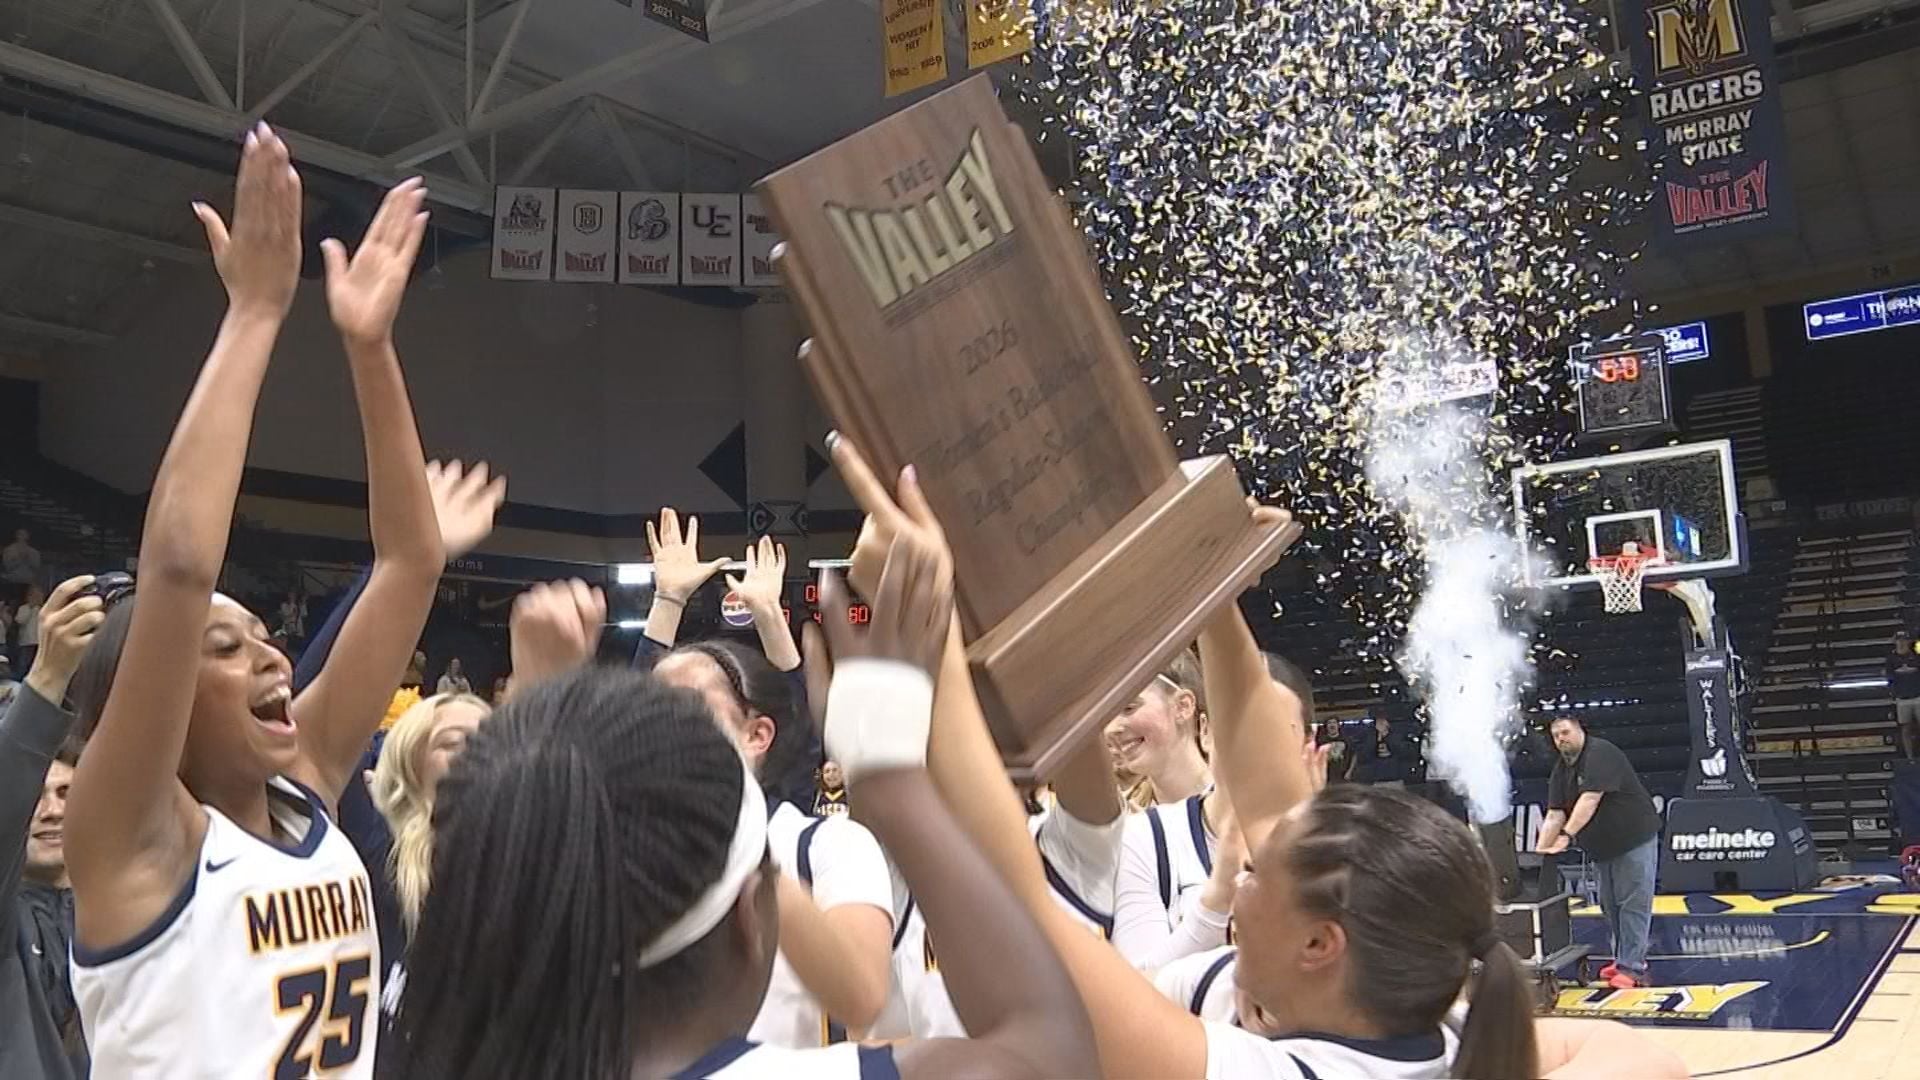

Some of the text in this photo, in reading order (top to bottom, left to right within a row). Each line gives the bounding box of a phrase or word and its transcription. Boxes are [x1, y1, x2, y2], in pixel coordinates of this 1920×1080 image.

[1650, 69, 1763, 118] RACERS
[1665, 110, 1752, 146] MURRAY
[1681, 134, 1744, 166] STATE
[882, 158, 935, 199] THE
[1665, 159, 1768, 226] VALLEY
[823, 124, 1015, 309] VALLEY
[1672, 827, 1776, 850] meineke
[1676, 849, 1768, 860] car care center
[245, 876, 371, 953] MURRAY
[268, 953, 373, 1080] 25
